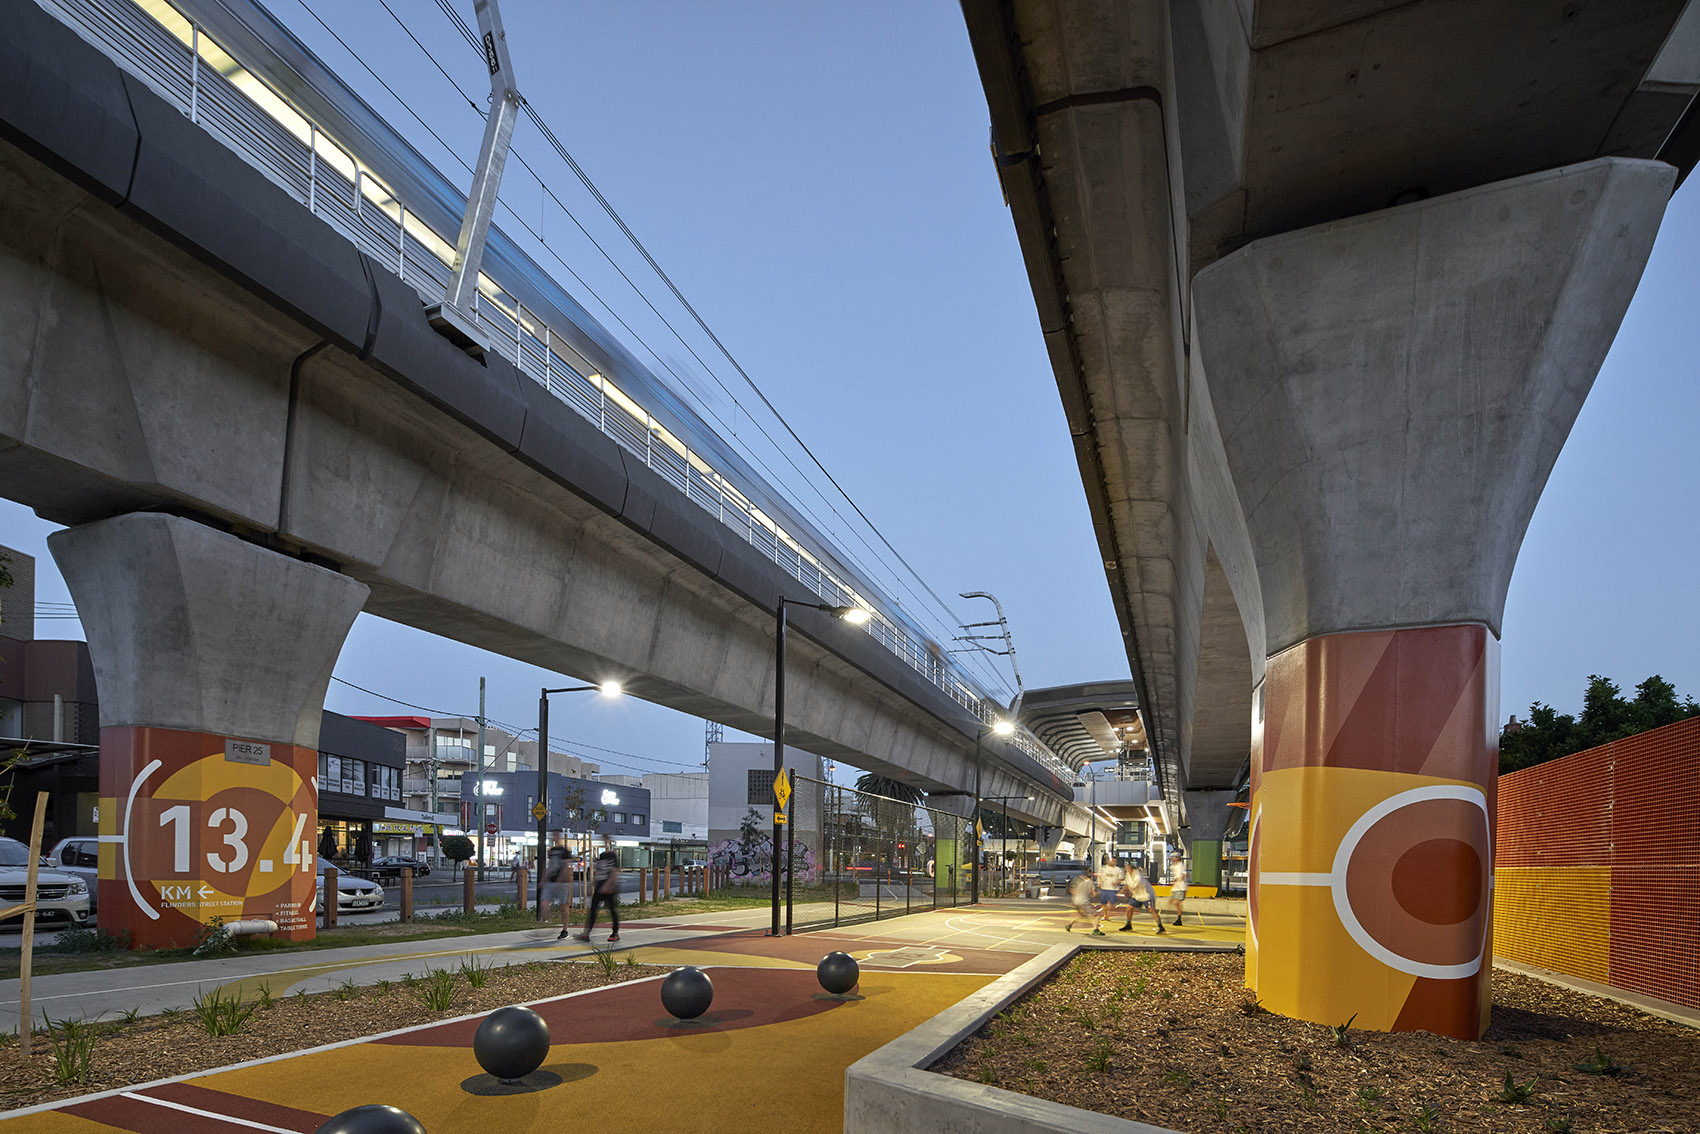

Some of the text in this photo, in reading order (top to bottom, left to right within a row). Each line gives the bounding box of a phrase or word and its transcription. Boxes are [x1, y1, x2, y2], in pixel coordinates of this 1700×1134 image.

[232, 743, 263, 756] PIER 25
[159, 805, 313, 873] 13.4
[161, 885, 191, 900] KM
[160, 901, 197, 909] FLINDERS
